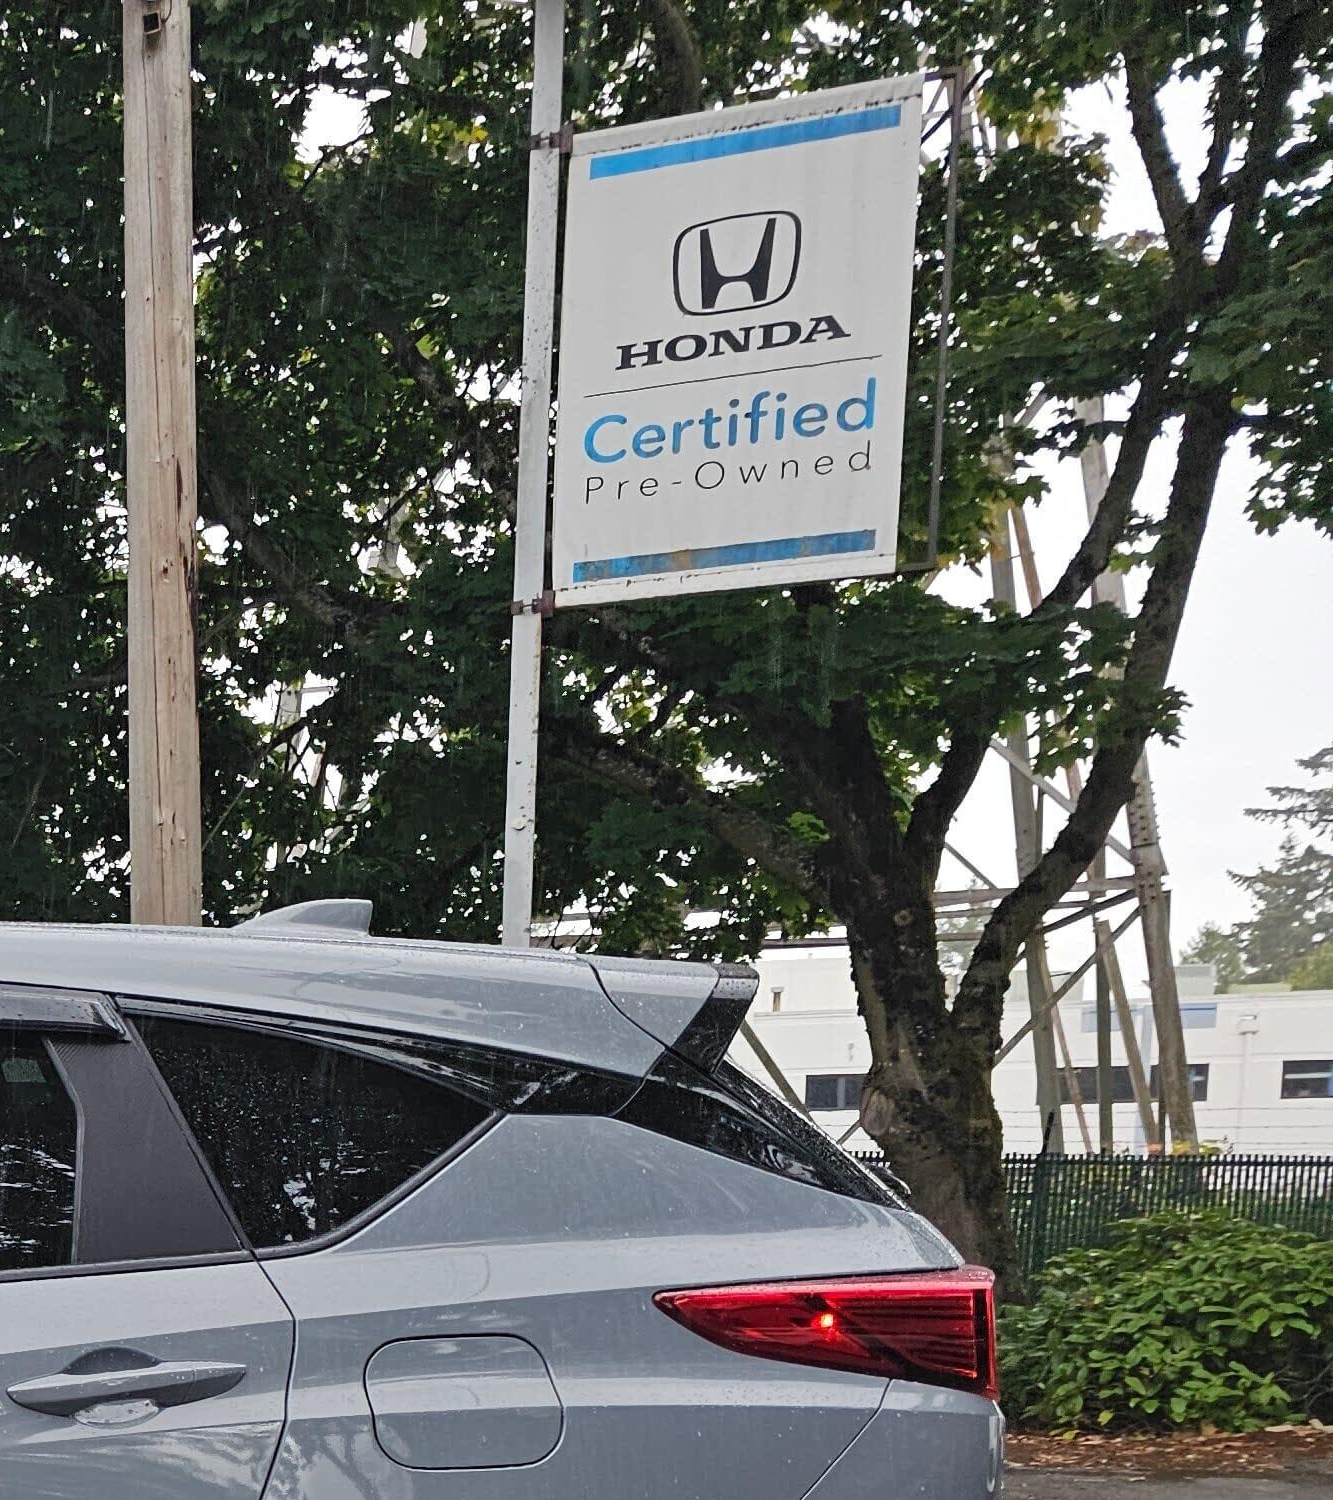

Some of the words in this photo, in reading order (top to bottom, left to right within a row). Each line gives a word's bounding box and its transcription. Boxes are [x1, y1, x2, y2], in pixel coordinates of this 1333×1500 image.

[615, 314, 851, 370] HONDA
[584, 377, 876, 463] Certified
[585, 440, 871, 504] Pre-Owned
